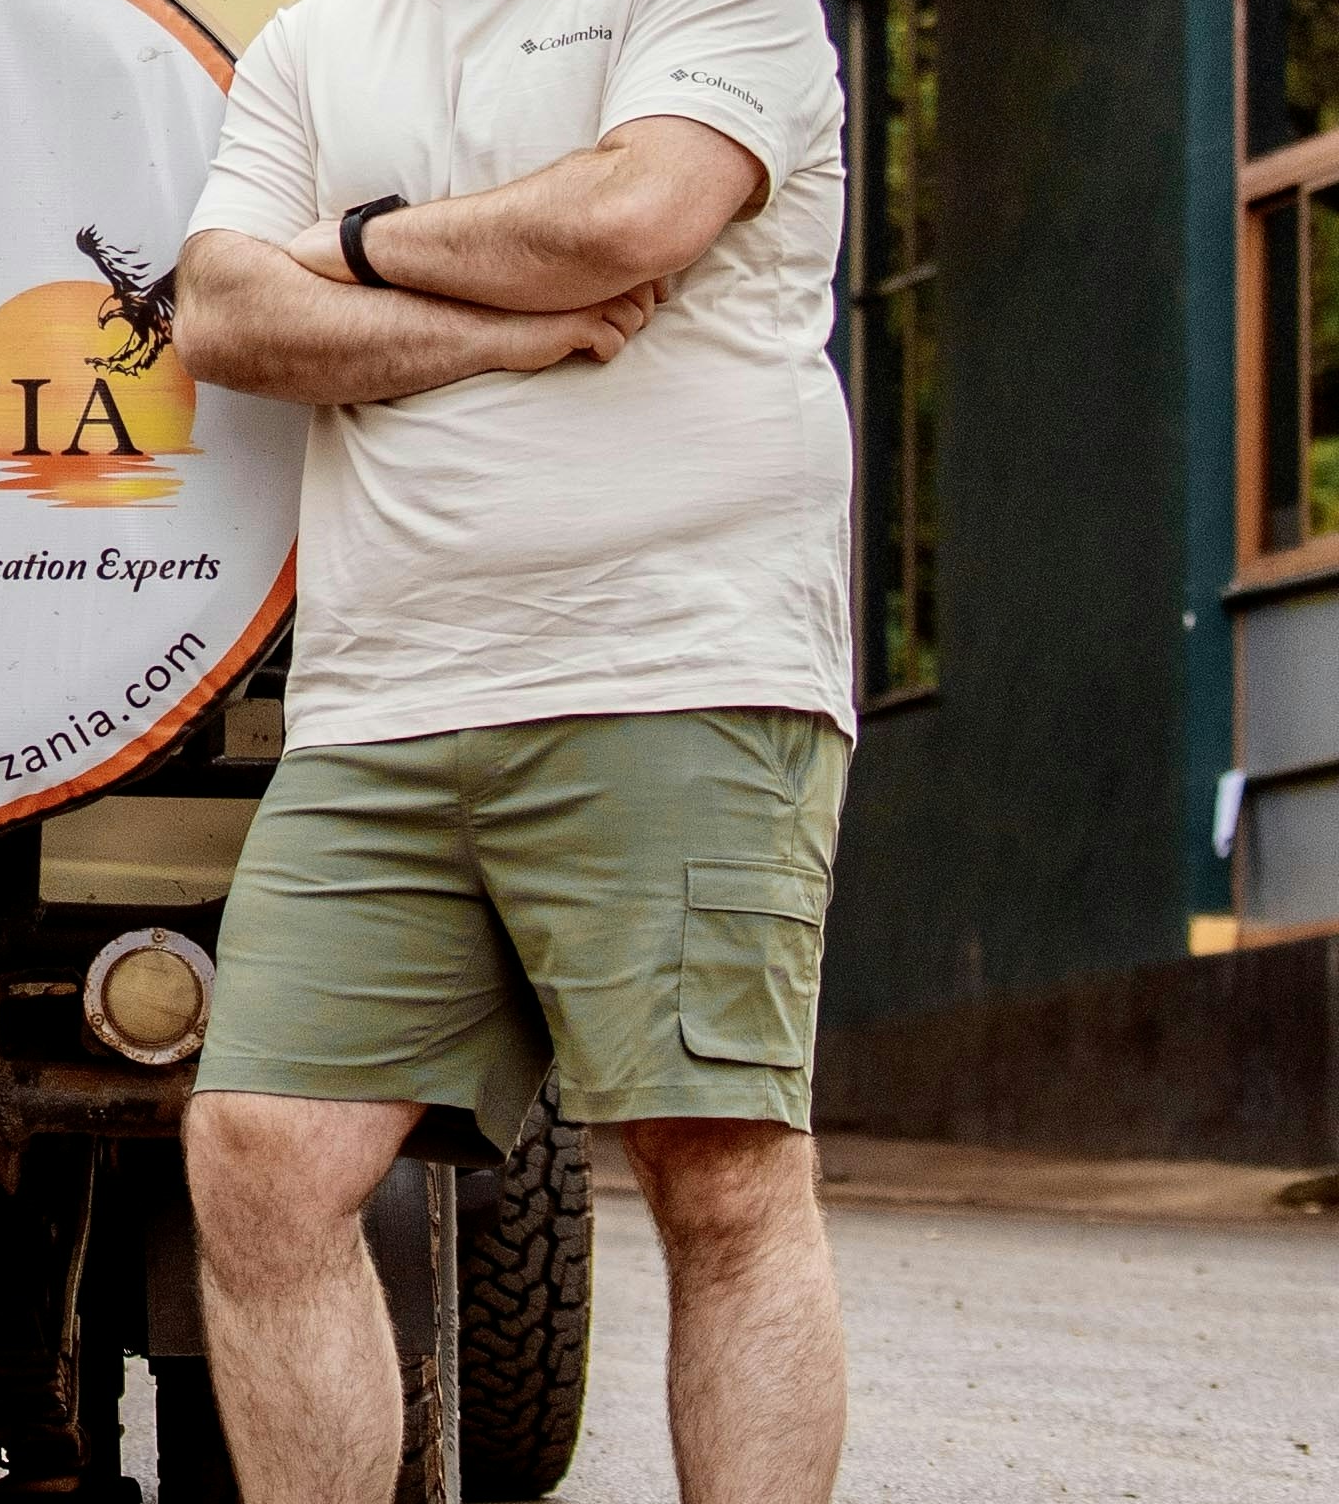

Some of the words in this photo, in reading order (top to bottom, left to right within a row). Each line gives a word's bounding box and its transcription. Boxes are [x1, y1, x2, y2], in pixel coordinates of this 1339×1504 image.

[539, 24, 613, 52] Columbia
[690, 71, 764, 114] Columbia
[95, 546, 220, 591] Experts
